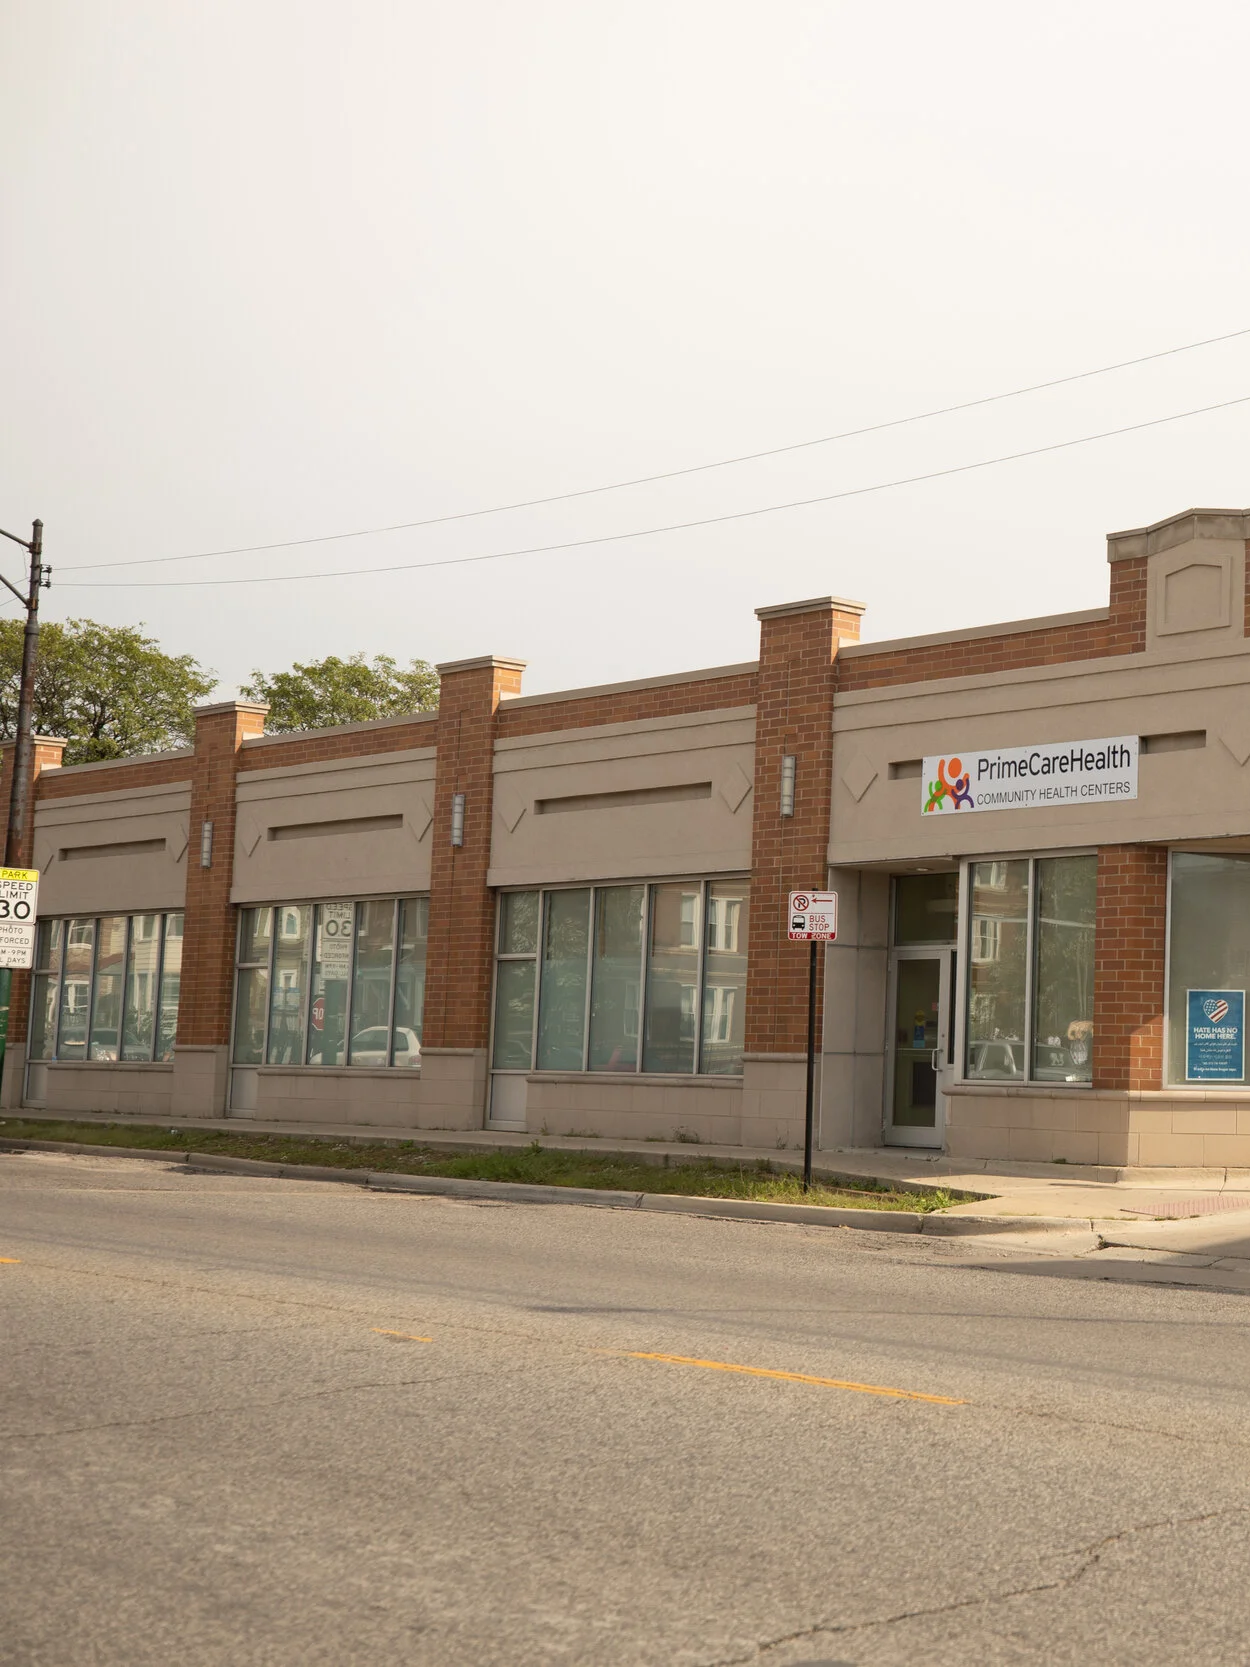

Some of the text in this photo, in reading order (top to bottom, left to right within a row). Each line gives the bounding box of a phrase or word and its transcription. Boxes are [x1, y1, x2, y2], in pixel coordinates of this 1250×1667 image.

[977, 744, 1131, 781] PrimeCareHealth
[977, 781, 1131, 805] COMMUNITY HEALTH CENTERS
[1, 870, 28, 880] PARK
[0, 891, 29, 900] LIMIT
[0, 899, 31, 919] 30
[809, 915, 826, 923] BUS
[809, 923, 830, 931] STOP
